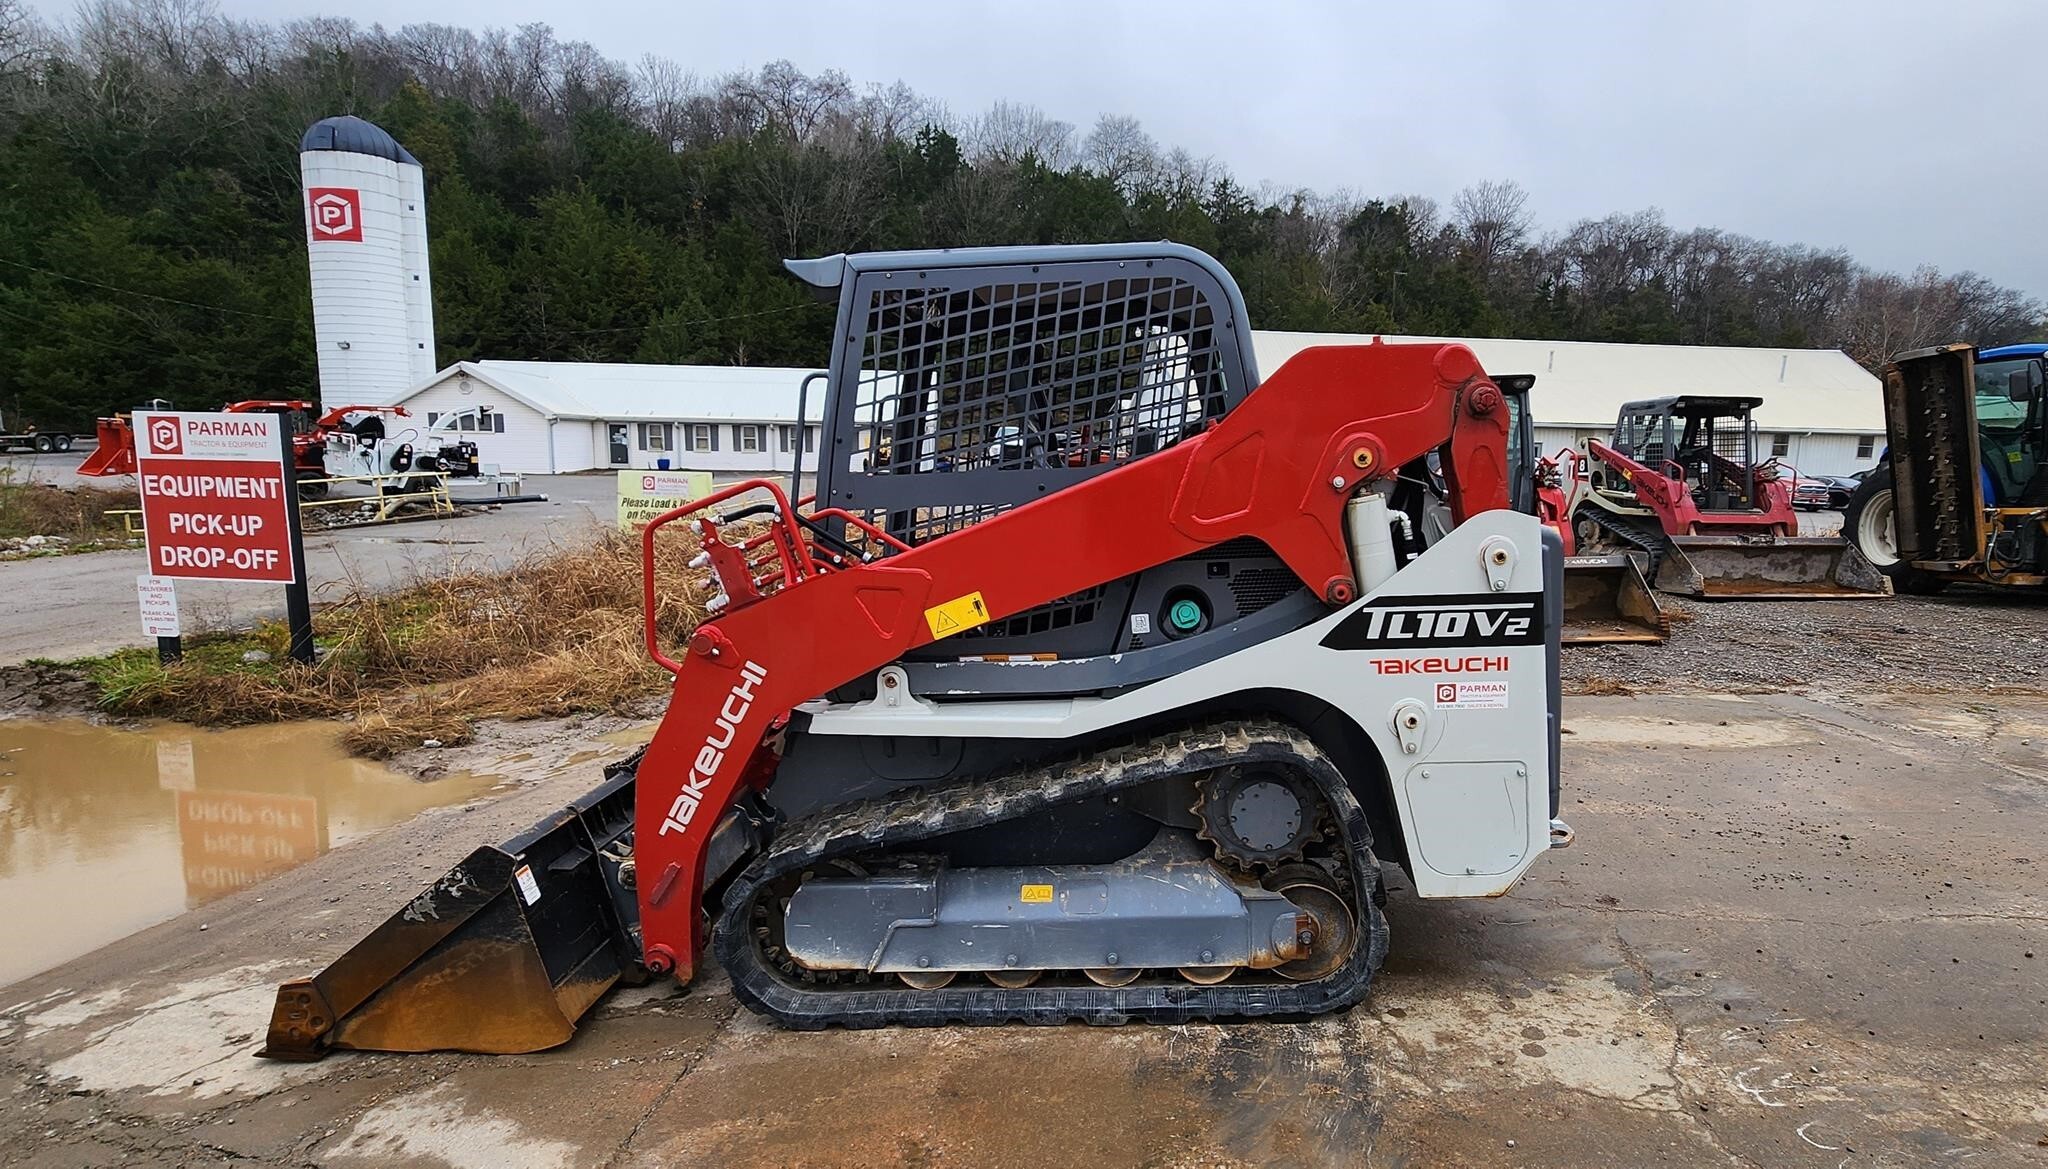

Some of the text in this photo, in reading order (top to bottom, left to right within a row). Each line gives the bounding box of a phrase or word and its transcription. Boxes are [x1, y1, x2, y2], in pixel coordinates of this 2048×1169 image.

[323, 206, 341, 224] P
[187, 421, 268, 437] PARMAN
[190, 440, 221, 449] TRACTOR
[228, 441, 268, 450] EQUIPMENT
[143, 474, 280, 499] EQUIPMENT
[621, 497, 650, 508] Please
[650, 498, 671, 509] Load
[671, 500, 677, 509] &
[626, 510, 639, 520] on
[168, 512, 263, 537] PICK-UP
[159, 545, 279, 571] DROP-OFF
[1363, 603, 1535, 640] TL10V2
